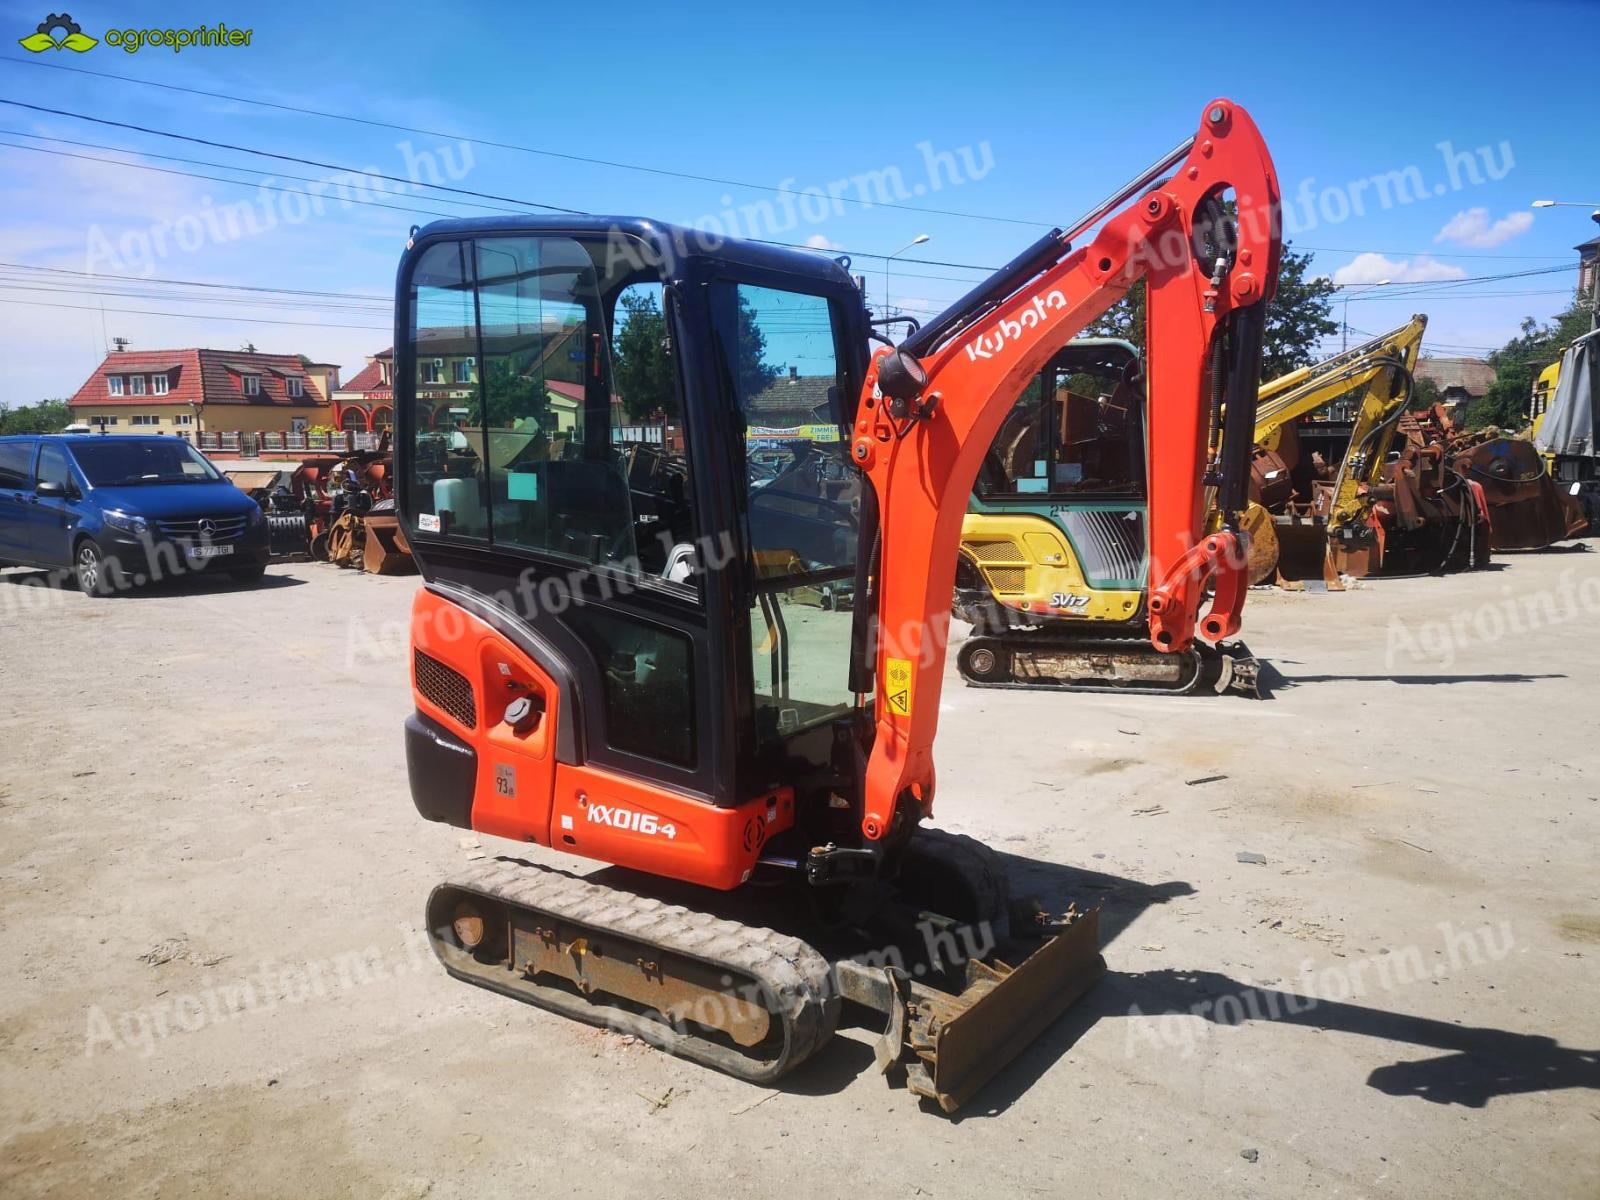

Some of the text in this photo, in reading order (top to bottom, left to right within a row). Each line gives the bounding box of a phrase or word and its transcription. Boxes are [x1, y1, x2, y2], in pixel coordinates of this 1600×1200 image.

[964, 289, 1068, 362] Kubota
[1049, 592, 1092, 608] SV17
[587, 803, 677, 840] KX016-4
